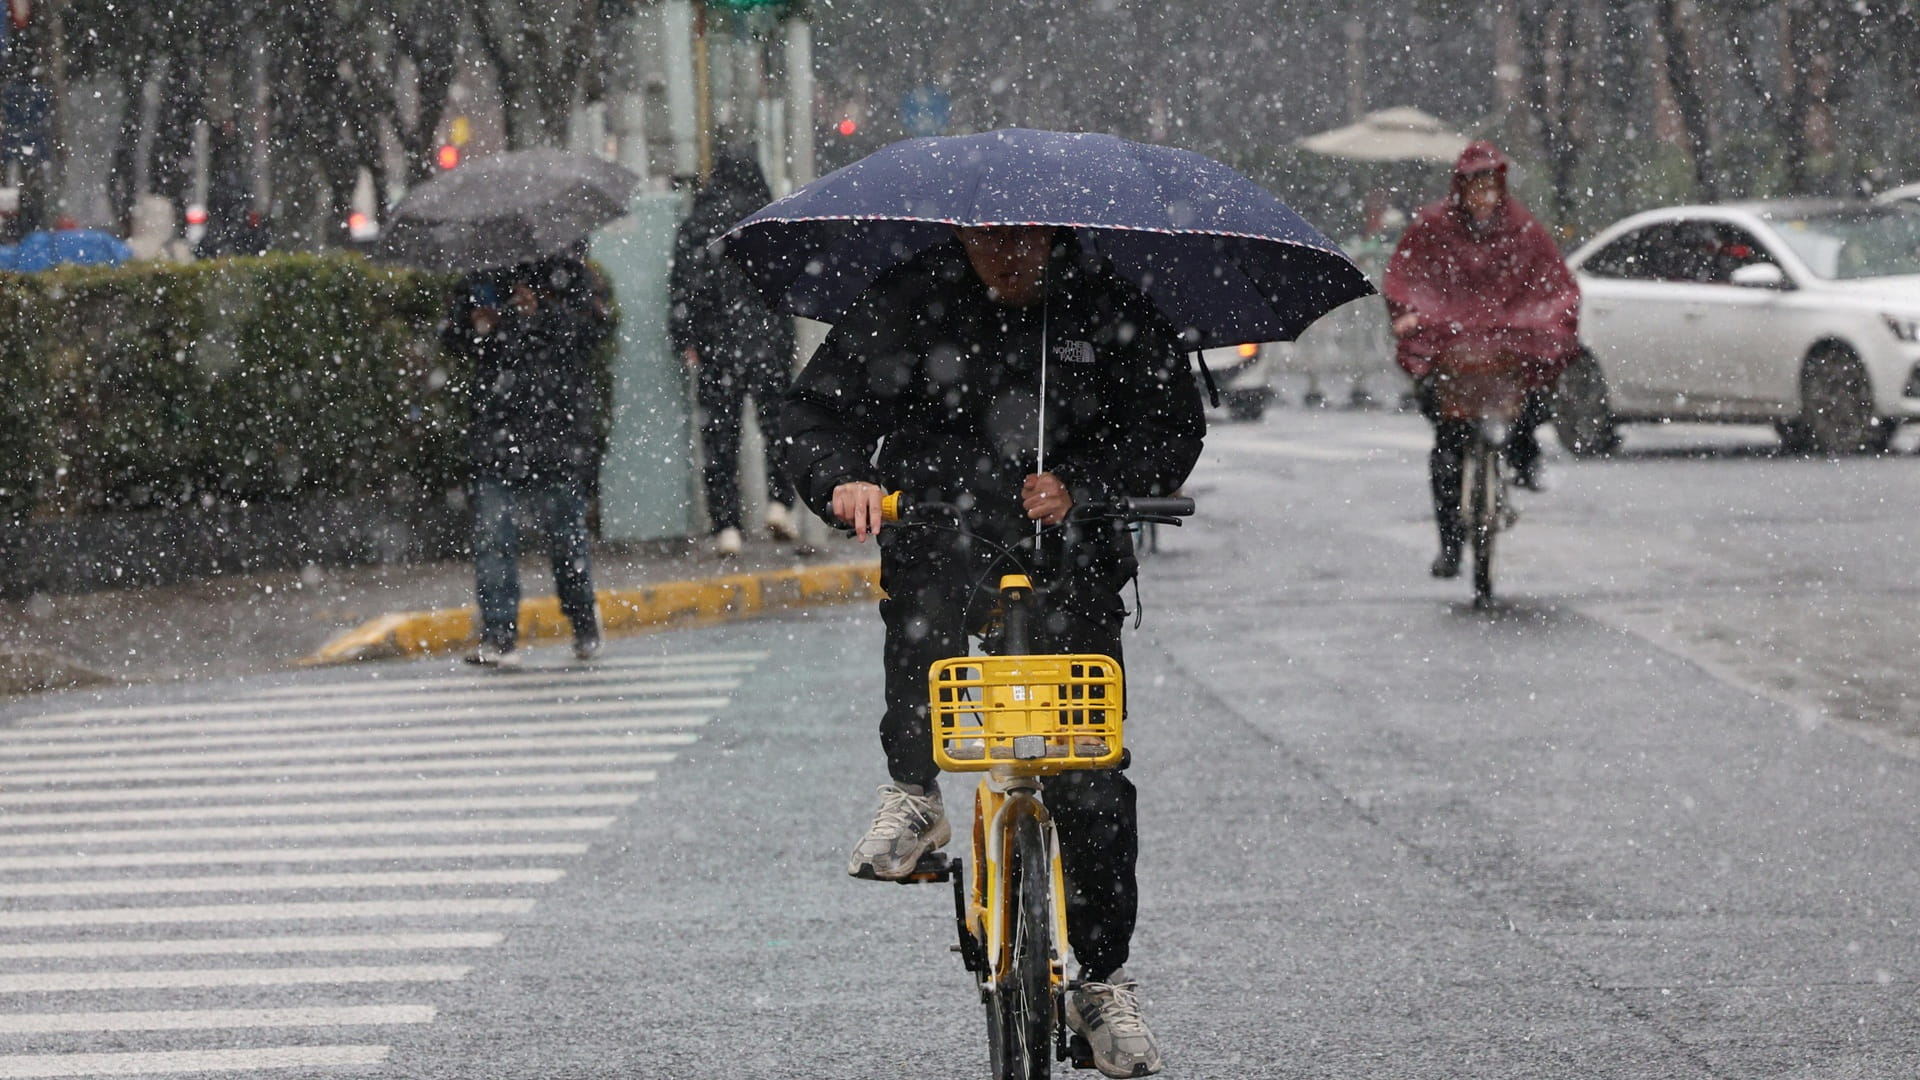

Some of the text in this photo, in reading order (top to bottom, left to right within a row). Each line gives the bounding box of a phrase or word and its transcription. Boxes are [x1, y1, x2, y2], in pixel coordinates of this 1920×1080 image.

[1065, 340, 1083, 348] THE
[1053, 346, 1082, 356] NORTH
[1060, 354, 1083, 362] FACE
